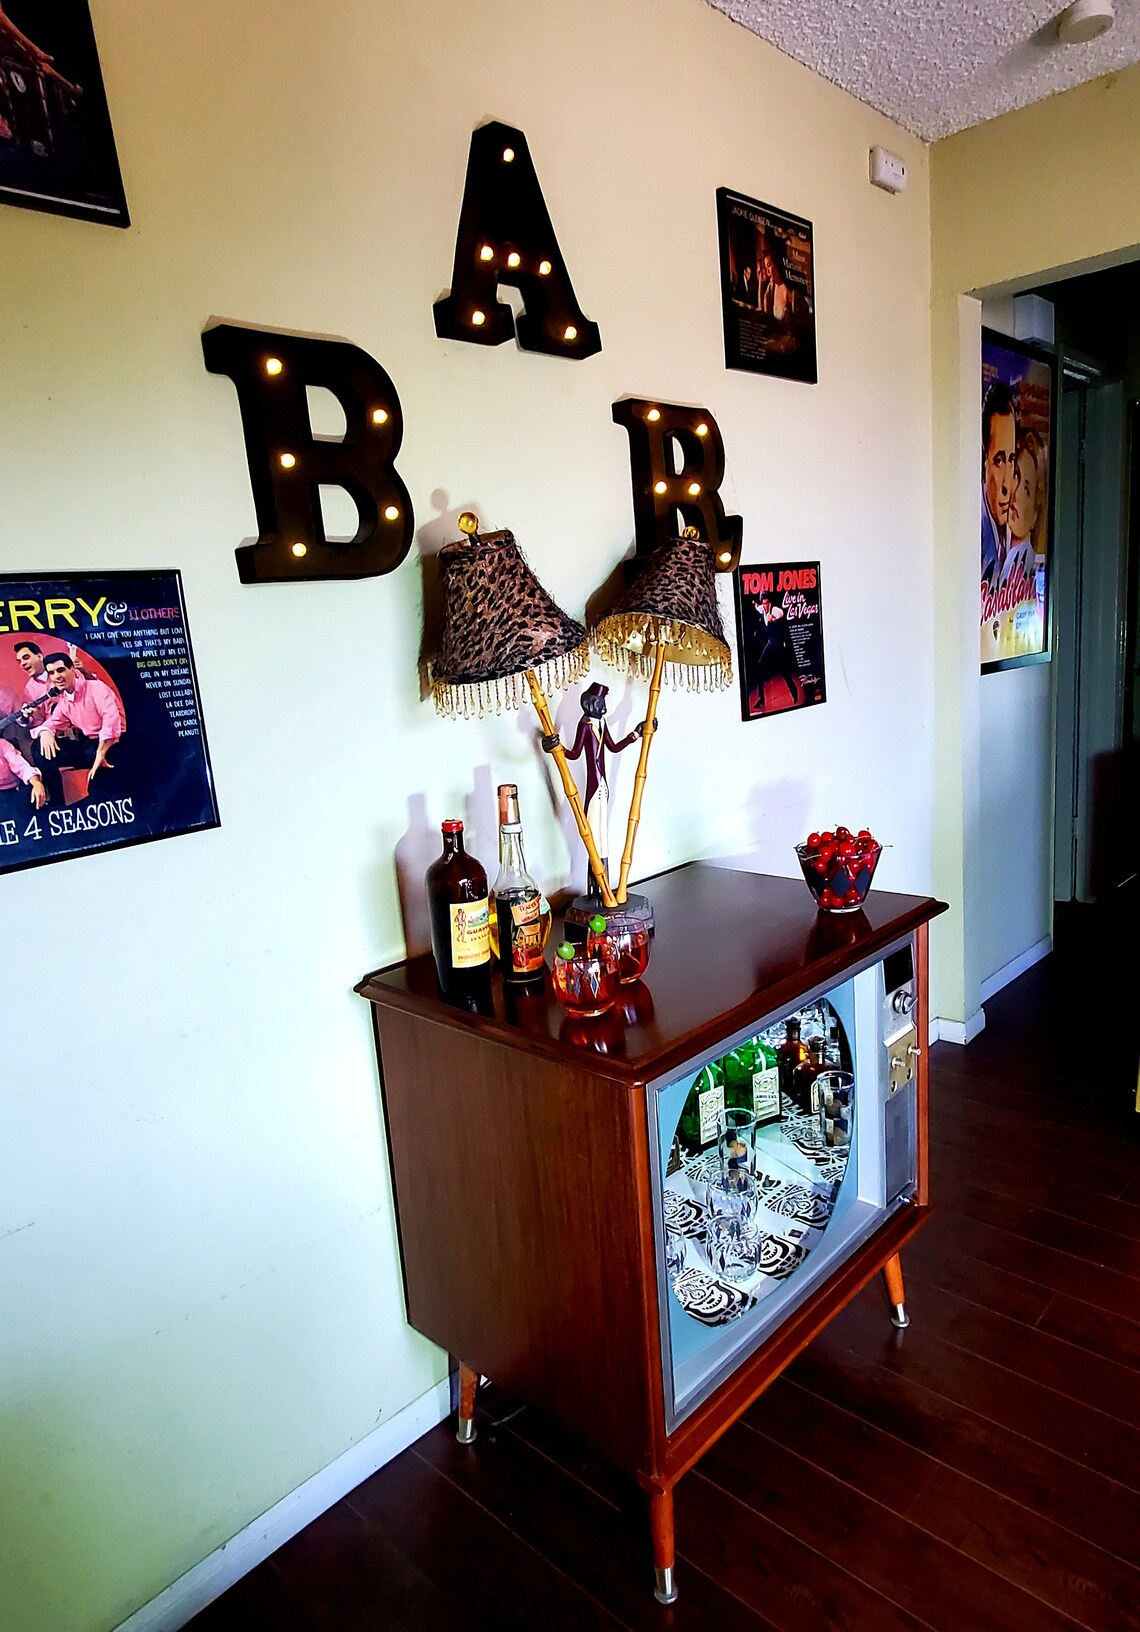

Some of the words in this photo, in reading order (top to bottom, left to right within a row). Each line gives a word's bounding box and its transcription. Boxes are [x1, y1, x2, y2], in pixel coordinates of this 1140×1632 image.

[742, 571, 774, 595] TOM
[776, 568, 817, 592] JONES
[781, 591, 797, 609] Live
[796, 591, 806, 603] in
[140, 607, 181, 620] OTHERS
[786, 603, 798, 621] Las
[796, 602, 819, 620] Vegas
[107, 630, 120, 639] GIVE
[121, 630, 132, 638] YOU
[133, 628, 159, 637] ANYTHING
[160, 627, 170, 636] BUT
[122, 641, 133, 649] YES
[134, 639, 143, 648] SIR
[130, 650, 141, 659] THE
[142, 649, 158, 658] APPLE
[136, 660, 146, 669] BIG
[146, 659, 161, 668] GIRLS
[140, 671, 152, 679] GIRL
[145, 681, 163, 690] NEVER
[158, 691, 171, 699] LOST
[165, 701, 173, 709] LA
[173, 700, 184, 708] DEE
[173, 720, 182, 728] OH
[182, 718, 198, 727] CAROL
[23, 815, 43, 840] 4
[49, 797, 135, 836] SEASONS
